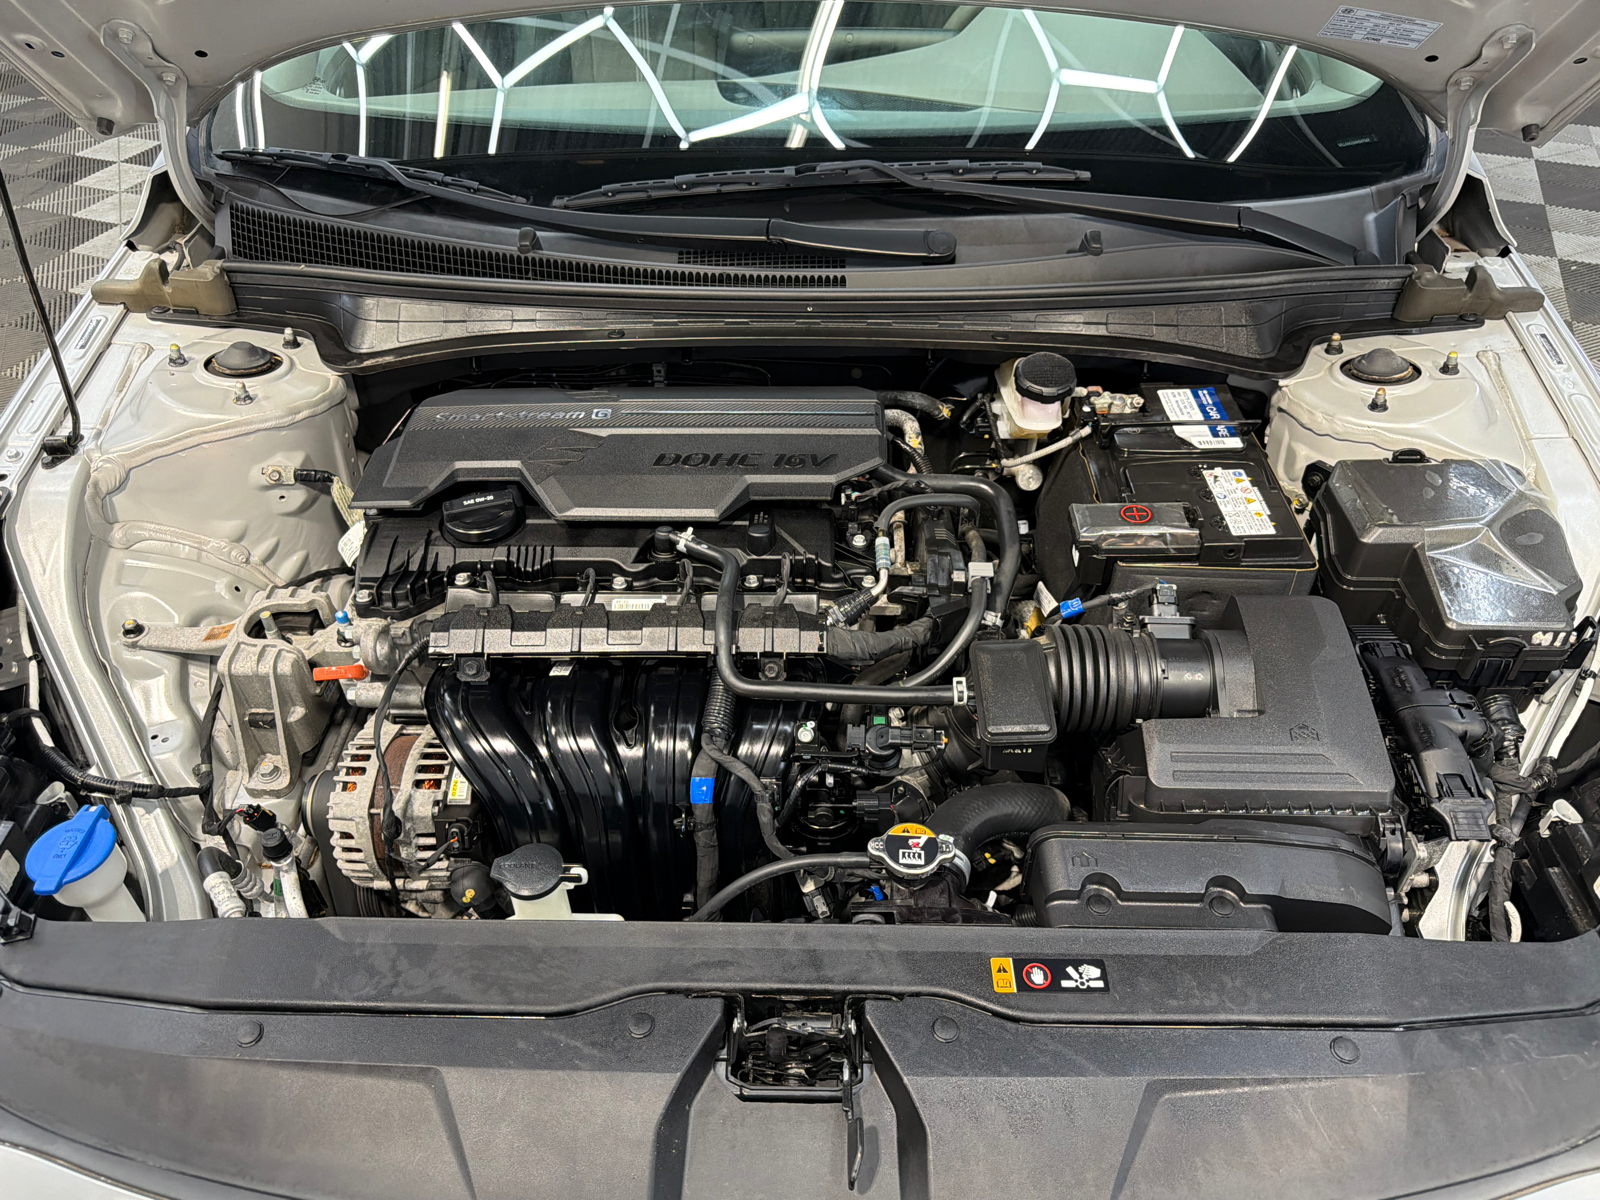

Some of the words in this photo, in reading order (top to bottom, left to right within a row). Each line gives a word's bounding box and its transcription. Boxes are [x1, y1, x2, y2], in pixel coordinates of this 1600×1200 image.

[435, 410, 586, 422] Smartstream
[1205, 406, 1221, 420] CAR
[652, 452, 764, 468] DOHC
[772, 452, 839, 468] 16V
[475, 495, 494, 503] 0W-20
[870, 841, 884, 849] HCC
